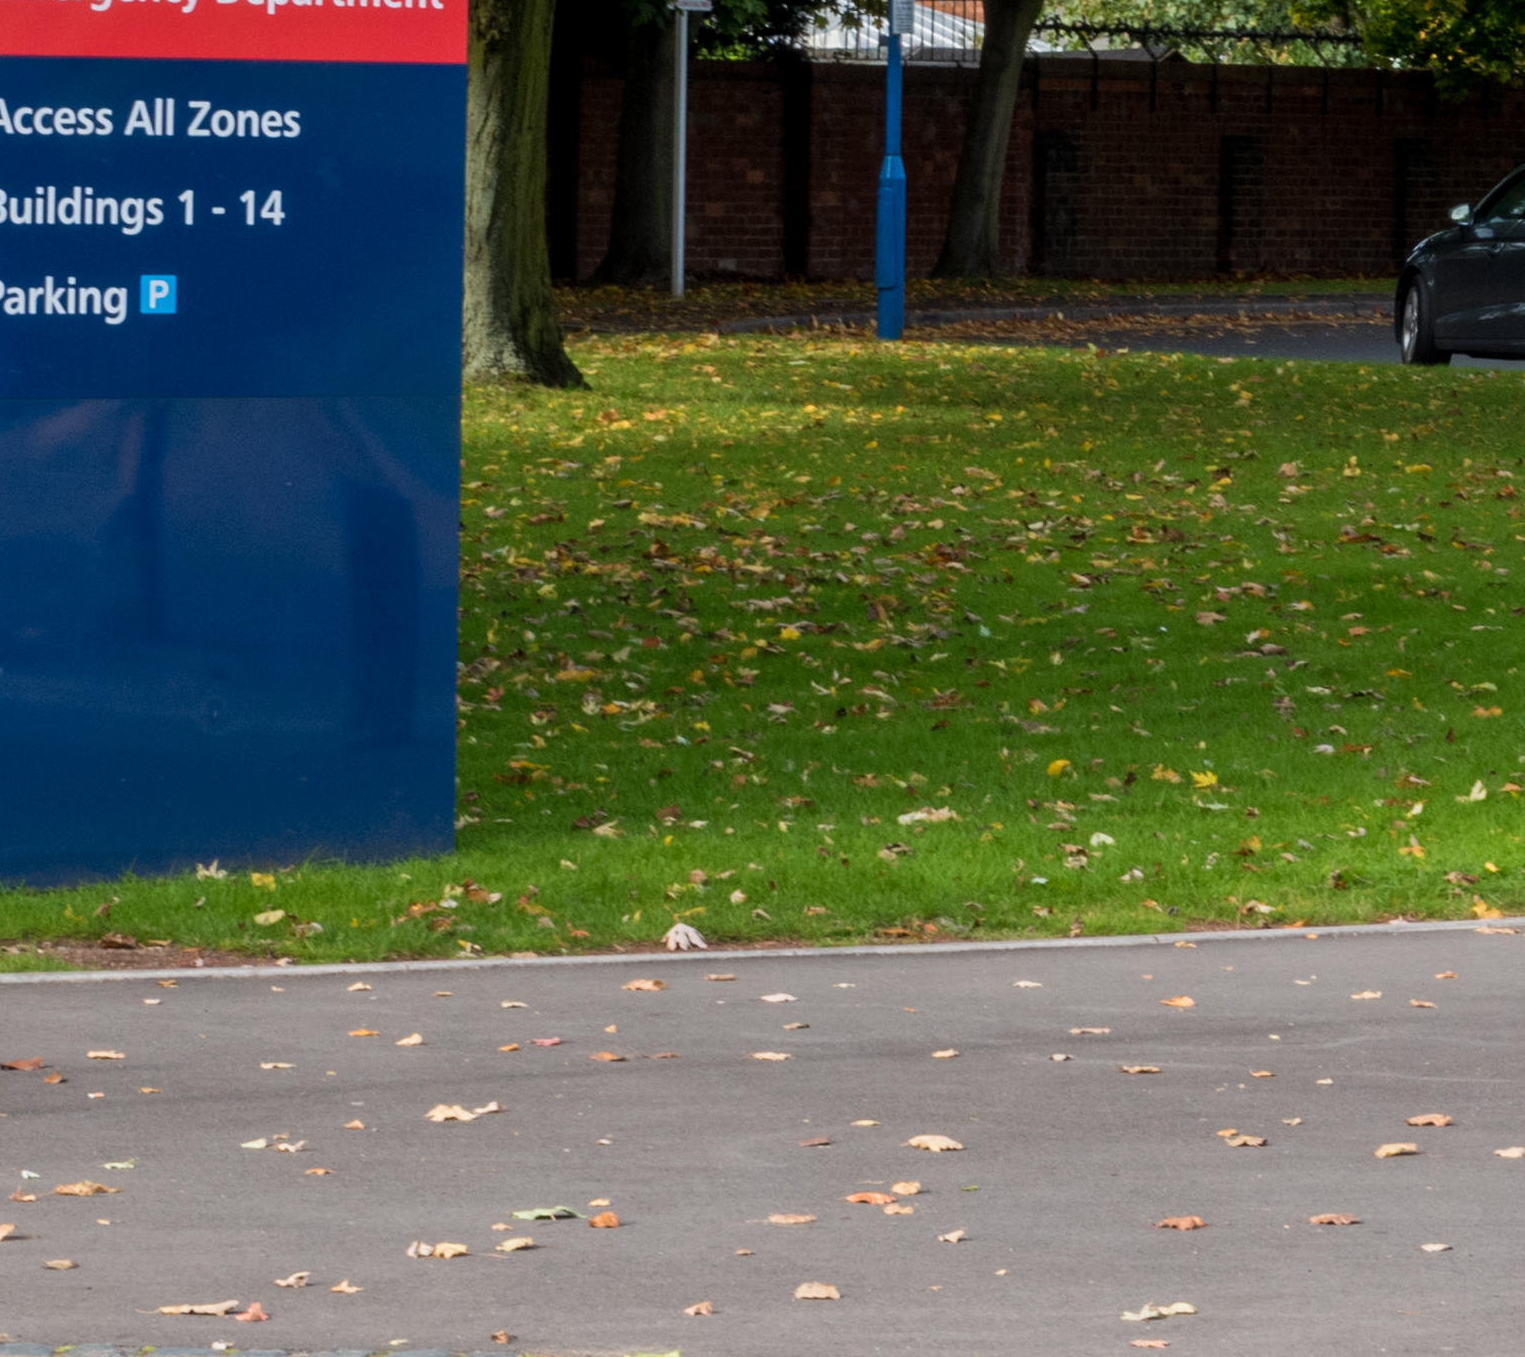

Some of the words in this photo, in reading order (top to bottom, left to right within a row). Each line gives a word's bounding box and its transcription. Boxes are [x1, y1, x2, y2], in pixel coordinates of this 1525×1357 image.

[123, 98, 176, 137] All
[186, 99, 302, 139] Zones
[177, 189, 195, 226] 1
[239, 189, 286, 227] 14
[147, 280, 170, 309] P
